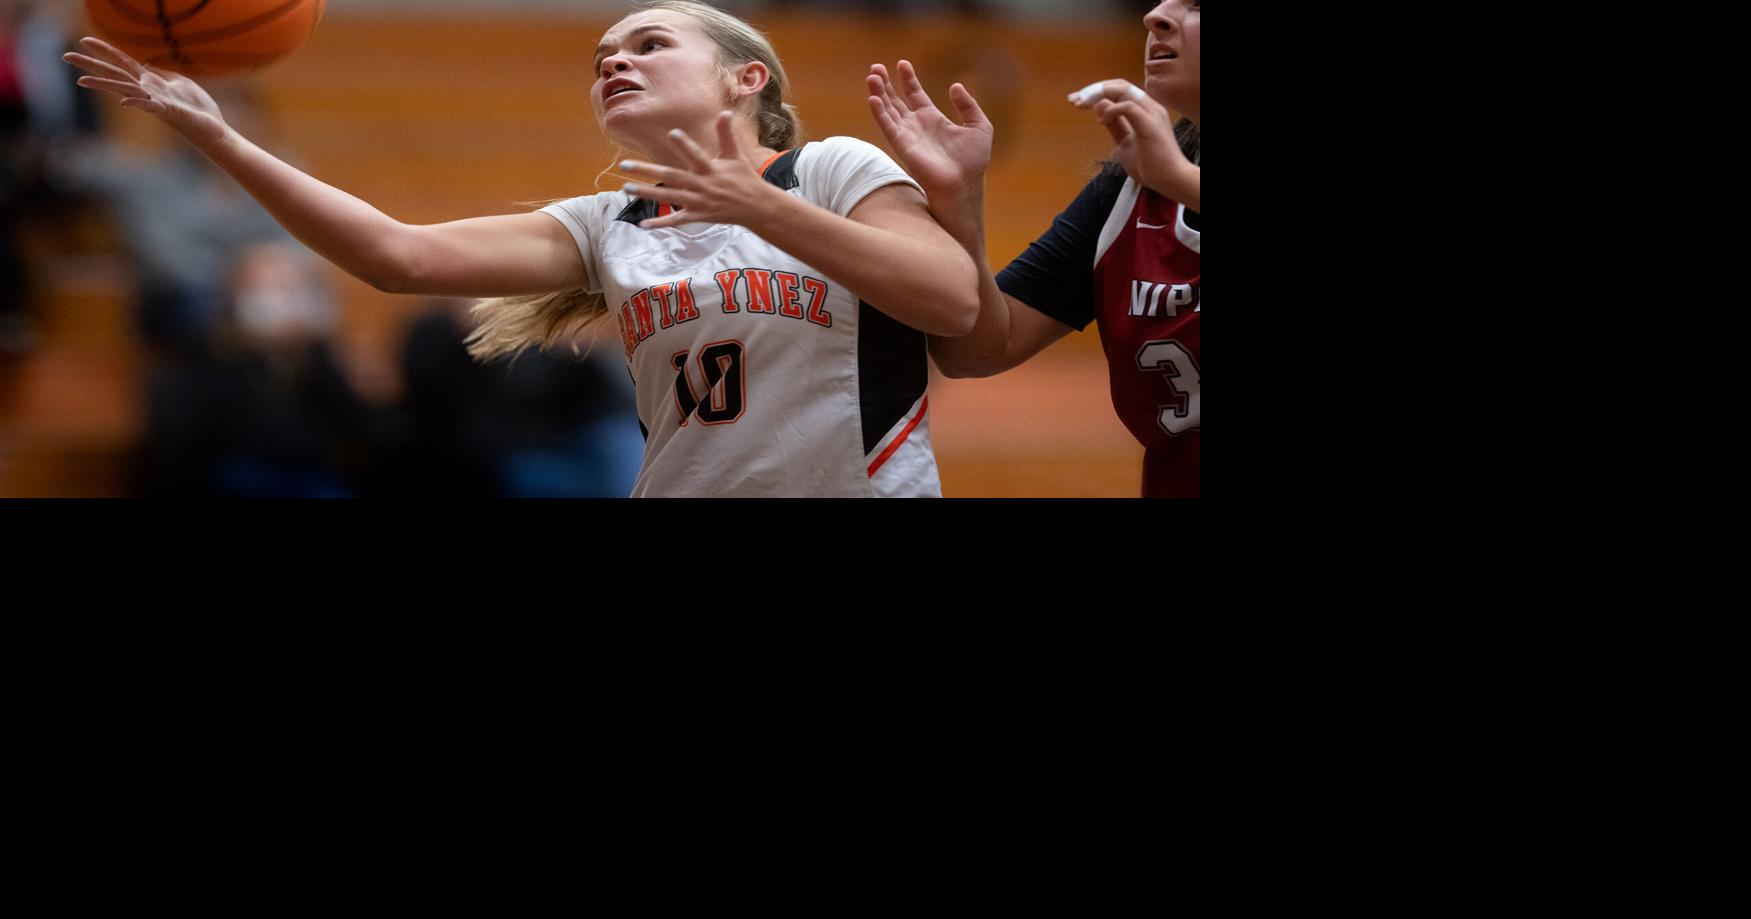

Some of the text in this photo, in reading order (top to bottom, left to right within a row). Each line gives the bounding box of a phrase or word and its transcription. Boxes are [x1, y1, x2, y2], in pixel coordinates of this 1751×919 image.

[618, 267, 832, 363] ANTA YNEZ
[671, 339, 747, 426] 10
